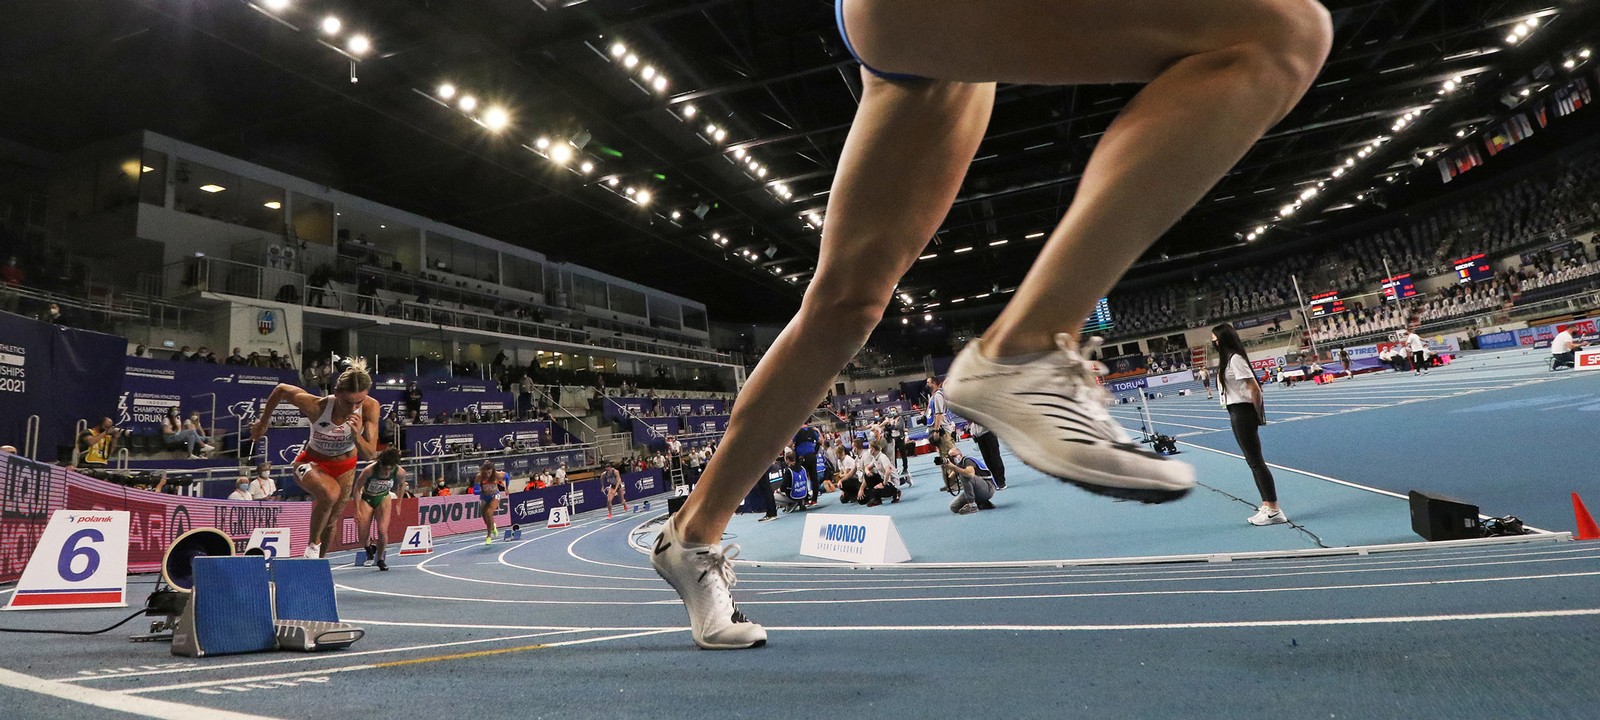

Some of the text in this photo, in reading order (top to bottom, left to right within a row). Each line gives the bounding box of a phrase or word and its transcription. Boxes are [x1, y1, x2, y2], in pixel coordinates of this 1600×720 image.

[1575, 322, 1595, 334] PAR
[1354, 346, 1377, 355] TIRES
[0, 379, 25, 392] 2021
[133, 413, 162, 423] TORUŃ
[420, 502, 463, 525] TOYO
[464, 497, 509, 520] TIS
[553, 511, 561, 524] 3
[77, 516, 113, 524] polanik
[408, 531, 421, 548] 4
[825, 523, 867, 544] MONDO
[58, 528, 104, 582] 6
[260, 537, 279, 563] 5
